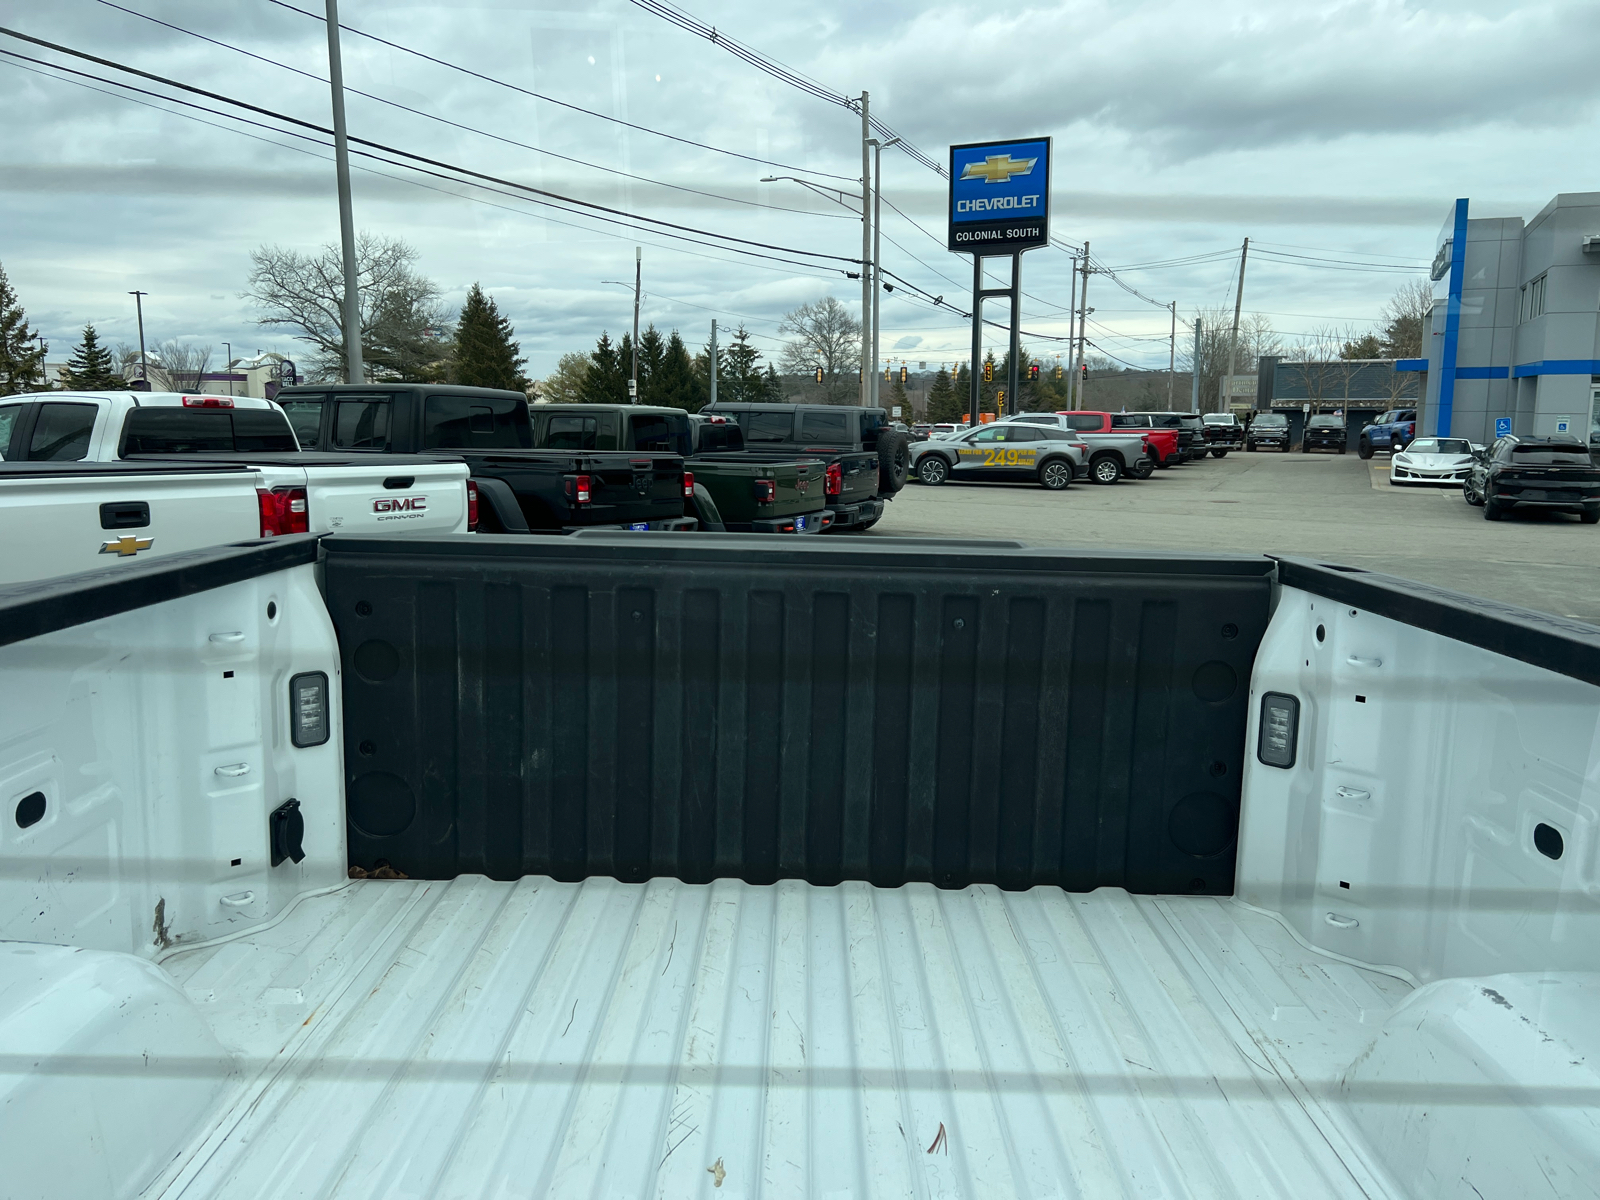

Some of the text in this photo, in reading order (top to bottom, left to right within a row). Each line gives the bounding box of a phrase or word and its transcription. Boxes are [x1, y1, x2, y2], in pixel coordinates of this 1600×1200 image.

[957, 194, 1040, 212] CHEVROLET
[956, 227, 1039, 241] COLONIAL SOUTH
[795, 478, 810, 492] Jeep
[373, 497, 427, 513] GMC
[377, 513, 425, 521] CANYON
